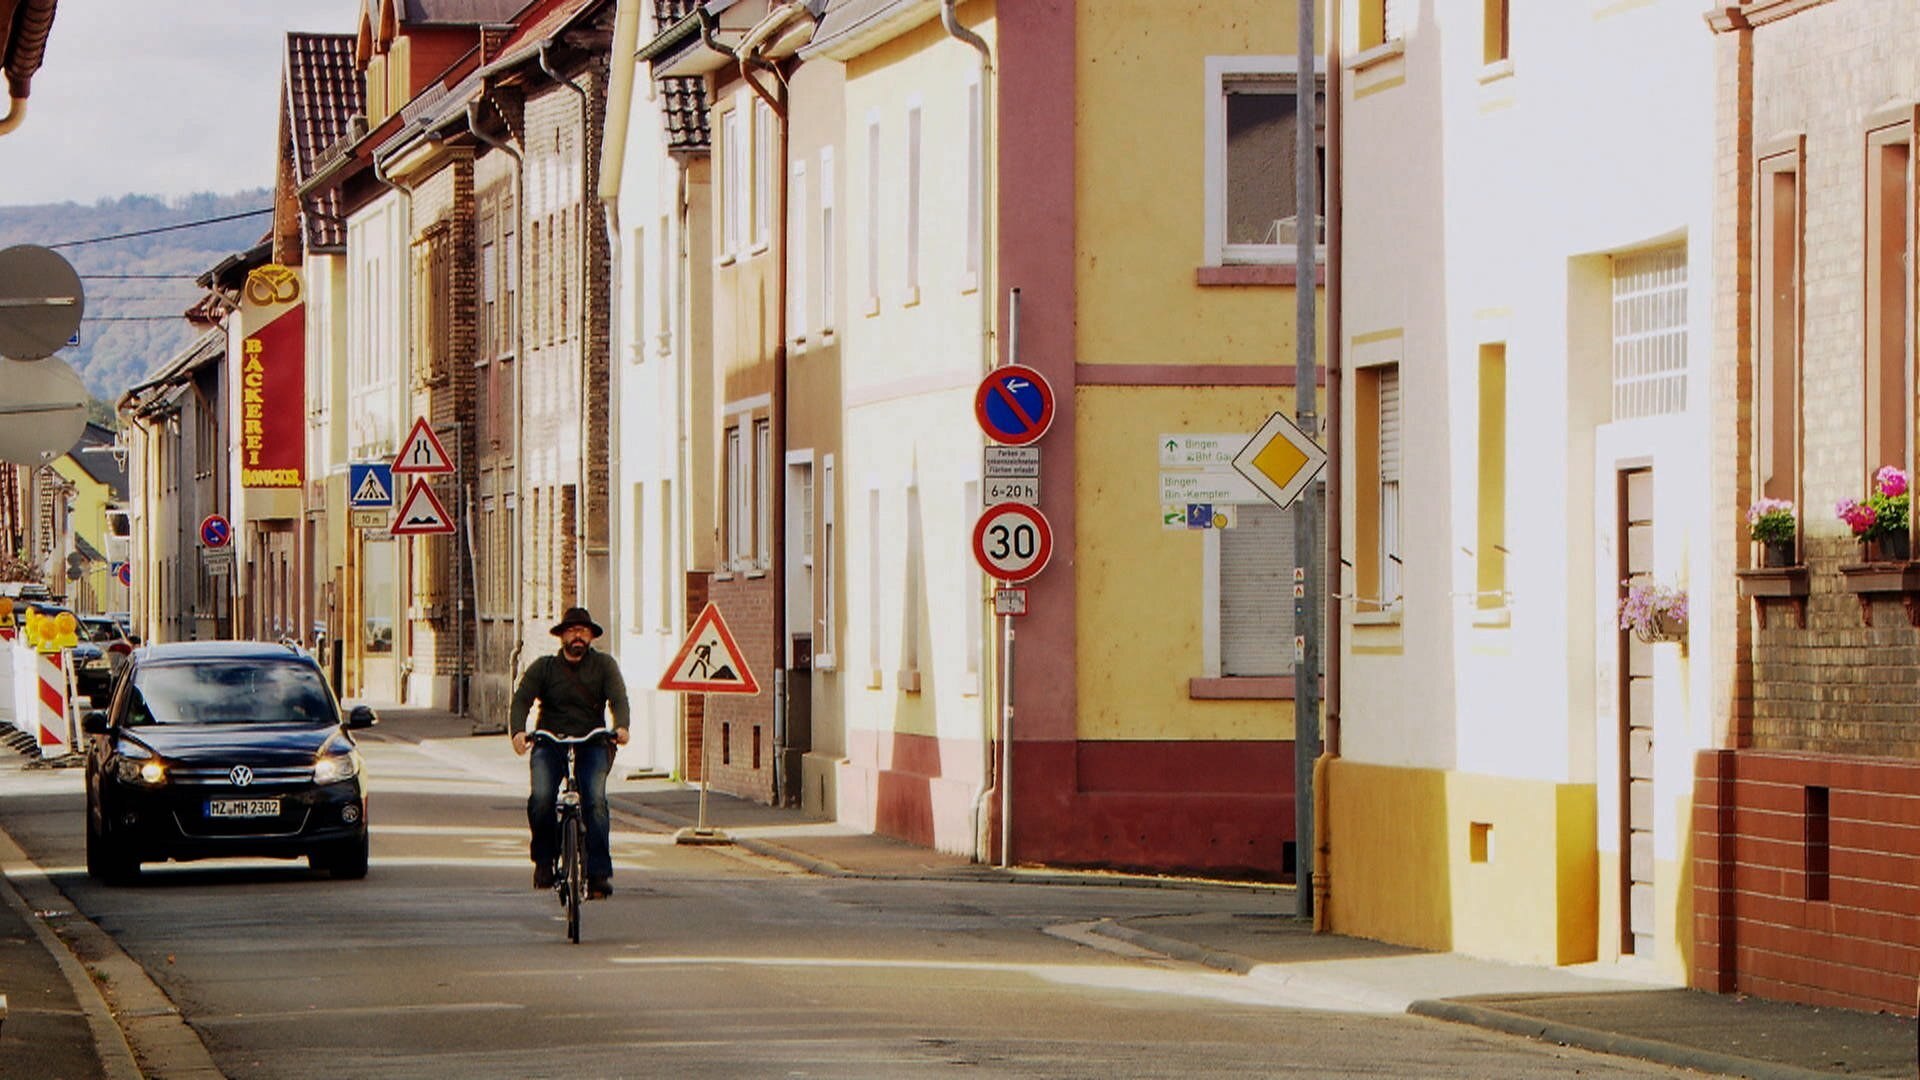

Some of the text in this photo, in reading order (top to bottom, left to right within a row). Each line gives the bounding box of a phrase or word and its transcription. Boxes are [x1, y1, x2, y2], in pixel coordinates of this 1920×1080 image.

[244, 339, 264, 465] BÄCKEREI
[1185, 439, 1218, 449] Bingen
[1164, 478, 1198, 488] Bingen
[991, 484, 1033, 497] 6-20 h
[989, 524, 1034, 559] 30
[250, 801, 278, 815] 2302
